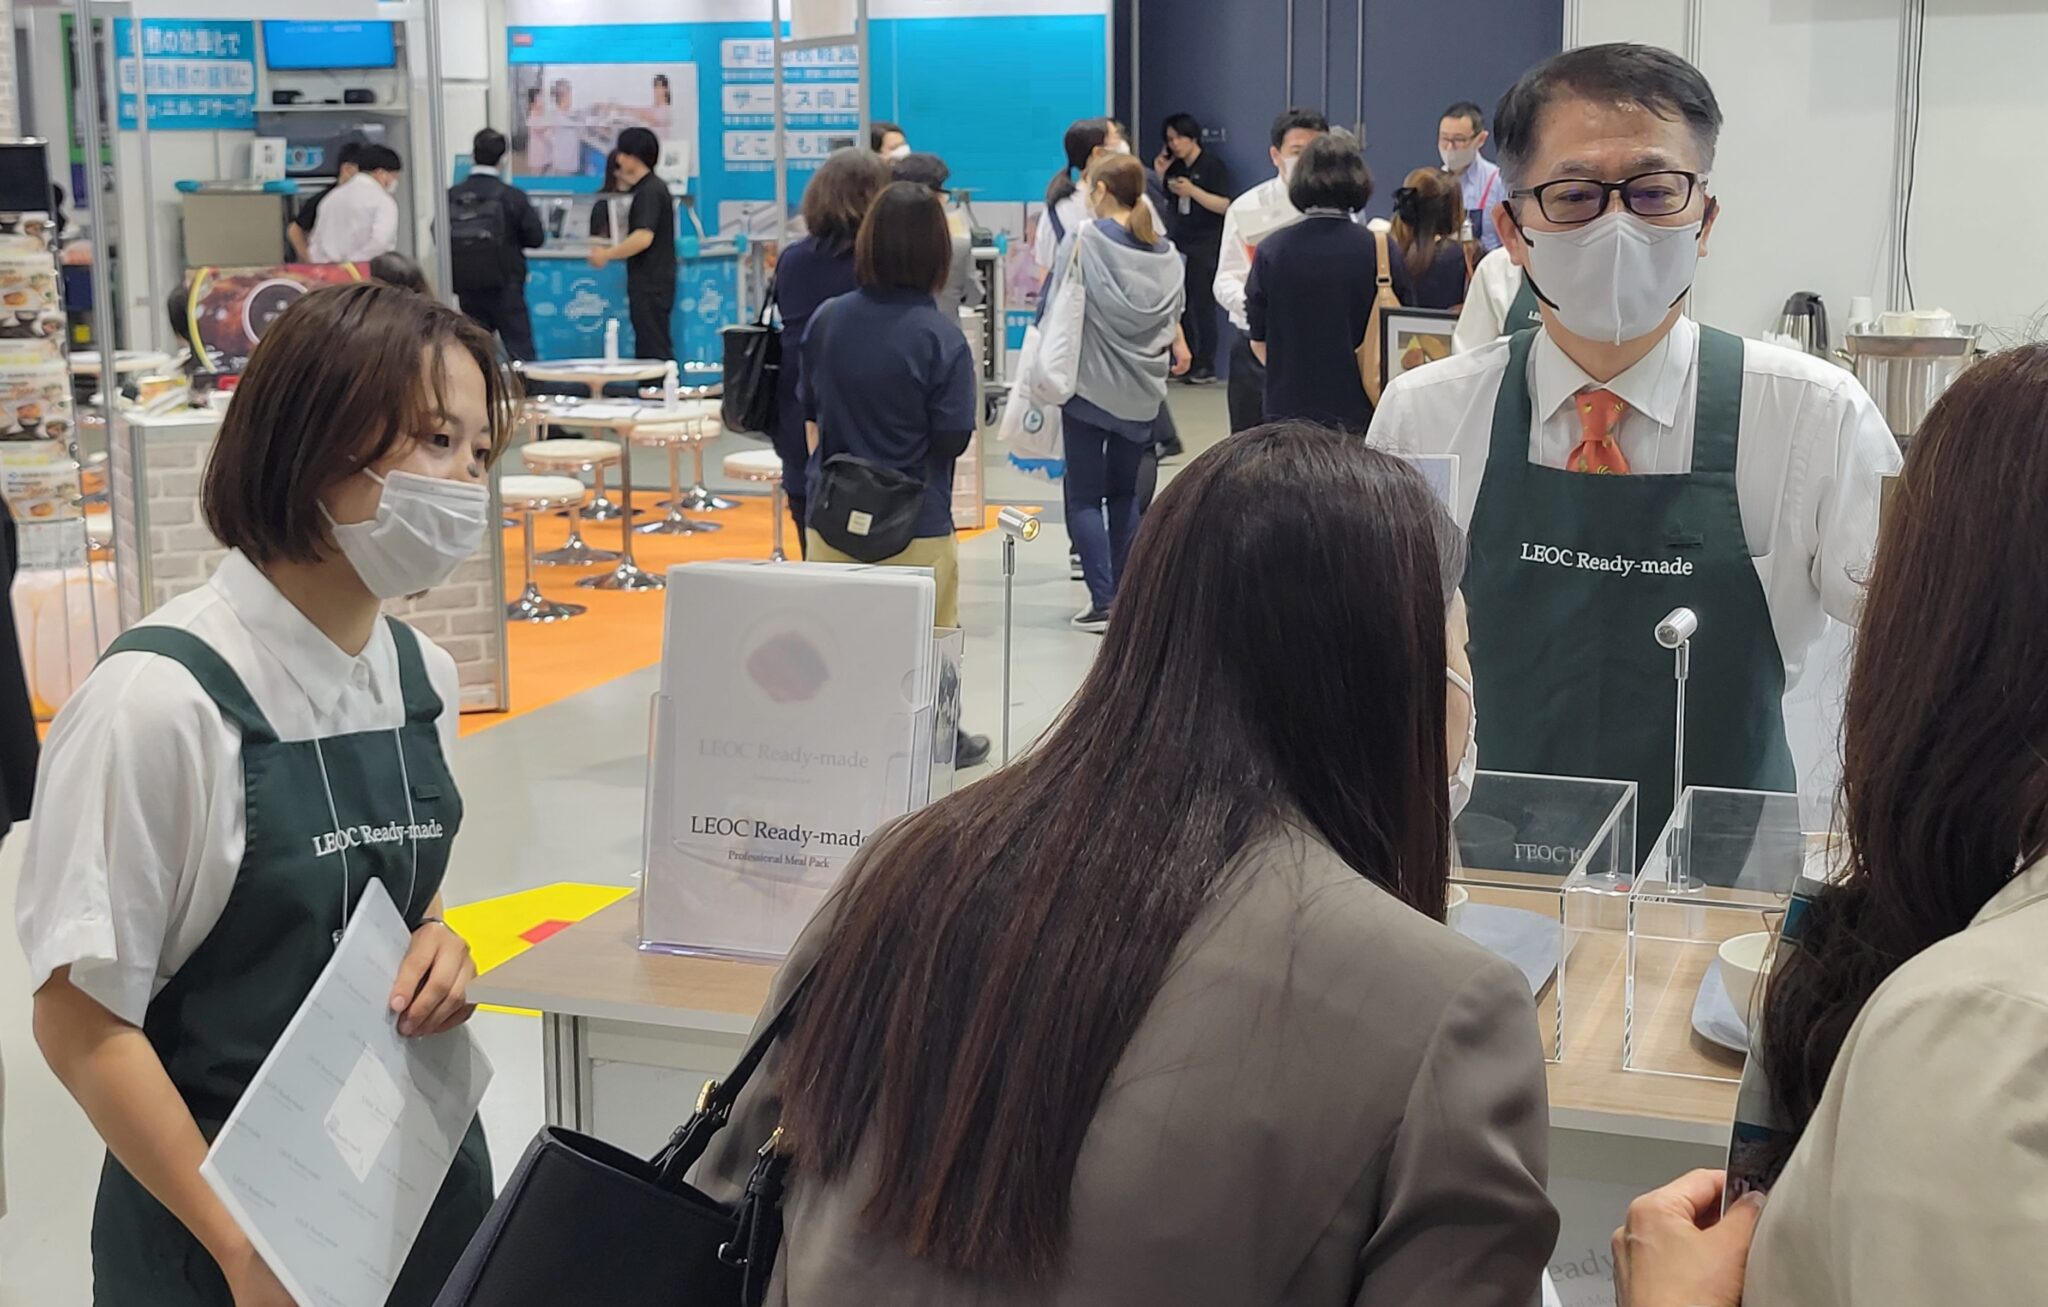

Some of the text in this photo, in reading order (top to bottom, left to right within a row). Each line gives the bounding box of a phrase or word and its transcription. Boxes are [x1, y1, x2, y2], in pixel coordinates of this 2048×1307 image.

[1520, 543, 1693, 577] LEOC Ready-made
[699, 739, 870, 769] LEOC Ready-made
[312, 818, 443, 857] LEOC Ready-made
[691, 815, 750, 838] LEOC
[728, 850, 830, 868] Professional Meal Pack
